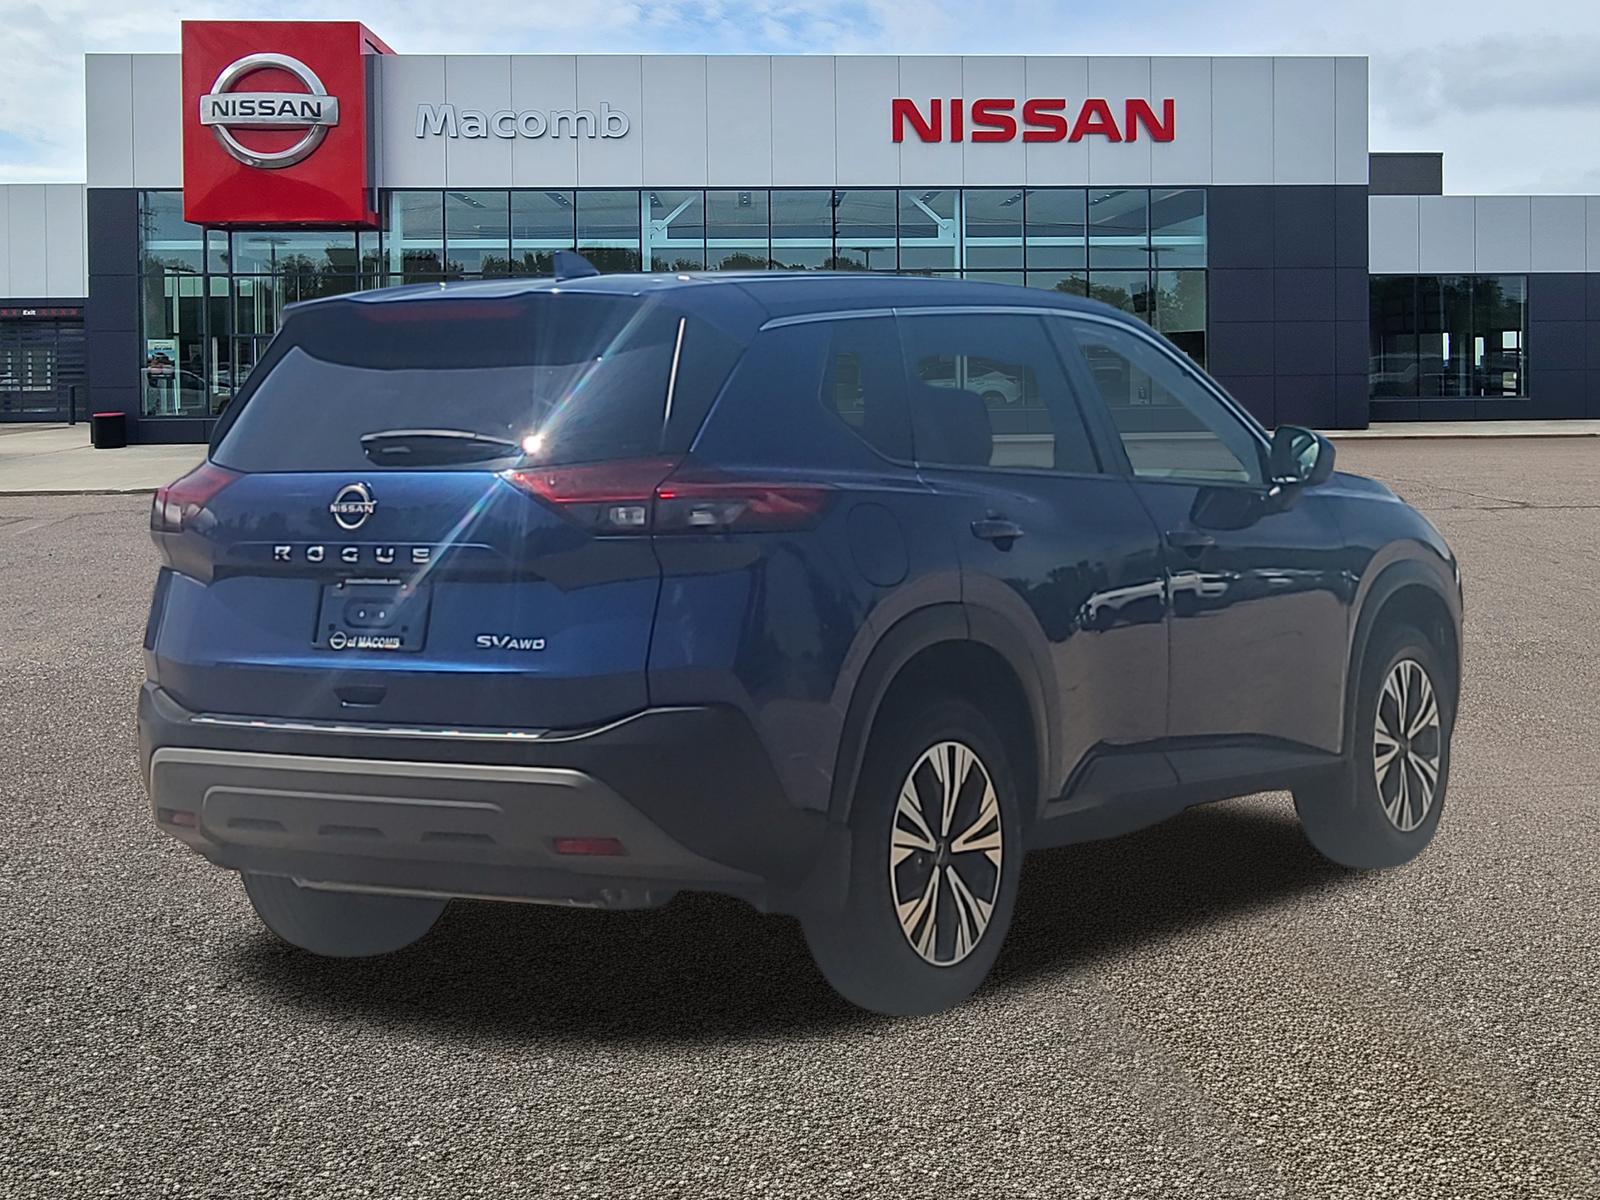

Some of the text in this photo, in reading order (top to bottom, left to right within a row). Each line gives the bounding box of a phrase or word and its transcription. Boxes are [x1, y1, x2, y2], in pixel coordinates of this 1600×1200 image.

[210, 99, 322, 118] NISSAN
[414, 101, 630, 140] Macomb
[890, 97, 1176, 143] NISSAN
[330, 503, 374, 514] NISSAN
[273, 545, 431, 564] ROGUE
[476, 635, 545, 650] SV AWD
